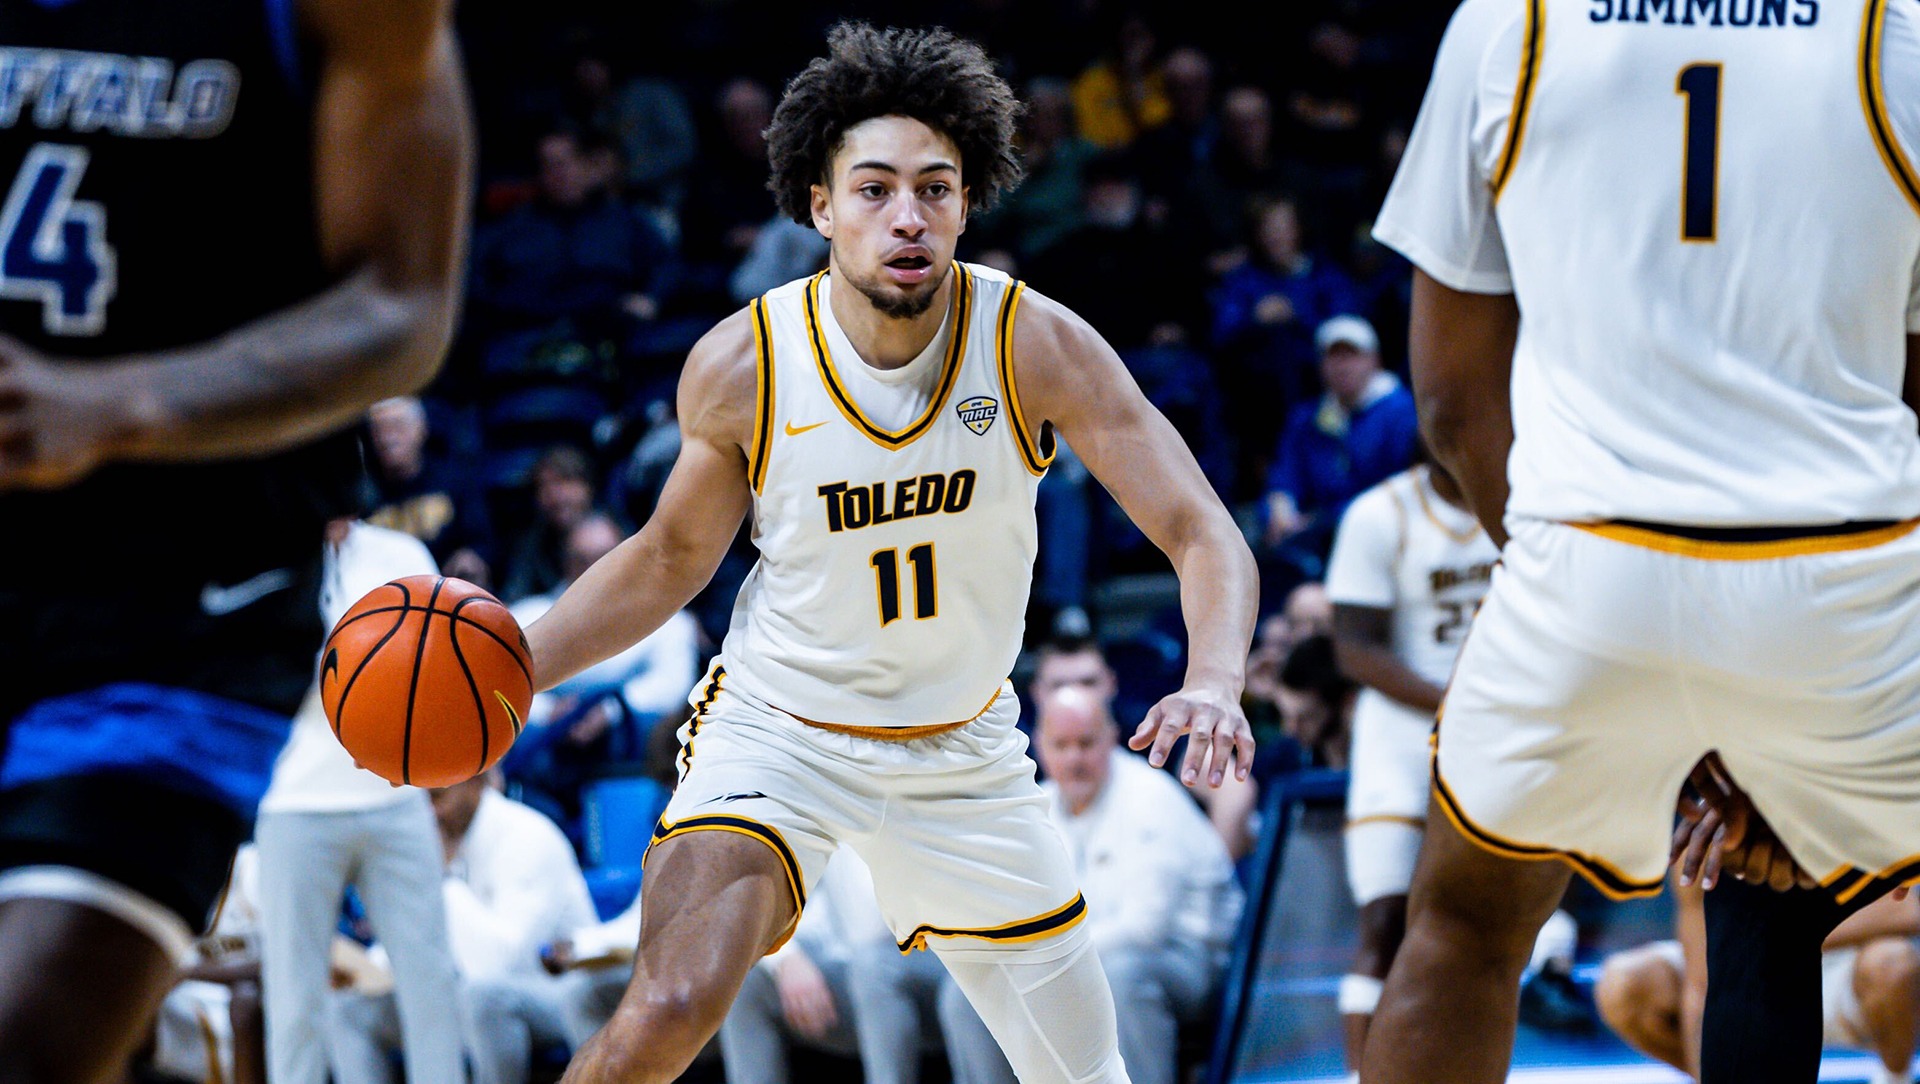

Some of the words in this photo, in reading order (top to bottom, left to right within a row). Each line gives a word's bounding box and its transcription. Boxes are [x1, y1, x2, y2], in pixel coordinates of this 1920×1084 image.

[1674, 60, 1723, 243] 1
[0, 141, 117, 336] 4
[960, 407, 997, 422] MAC
[817, 468, 976, 533] TOLEDO
[868, 540, 938, 628] 11
